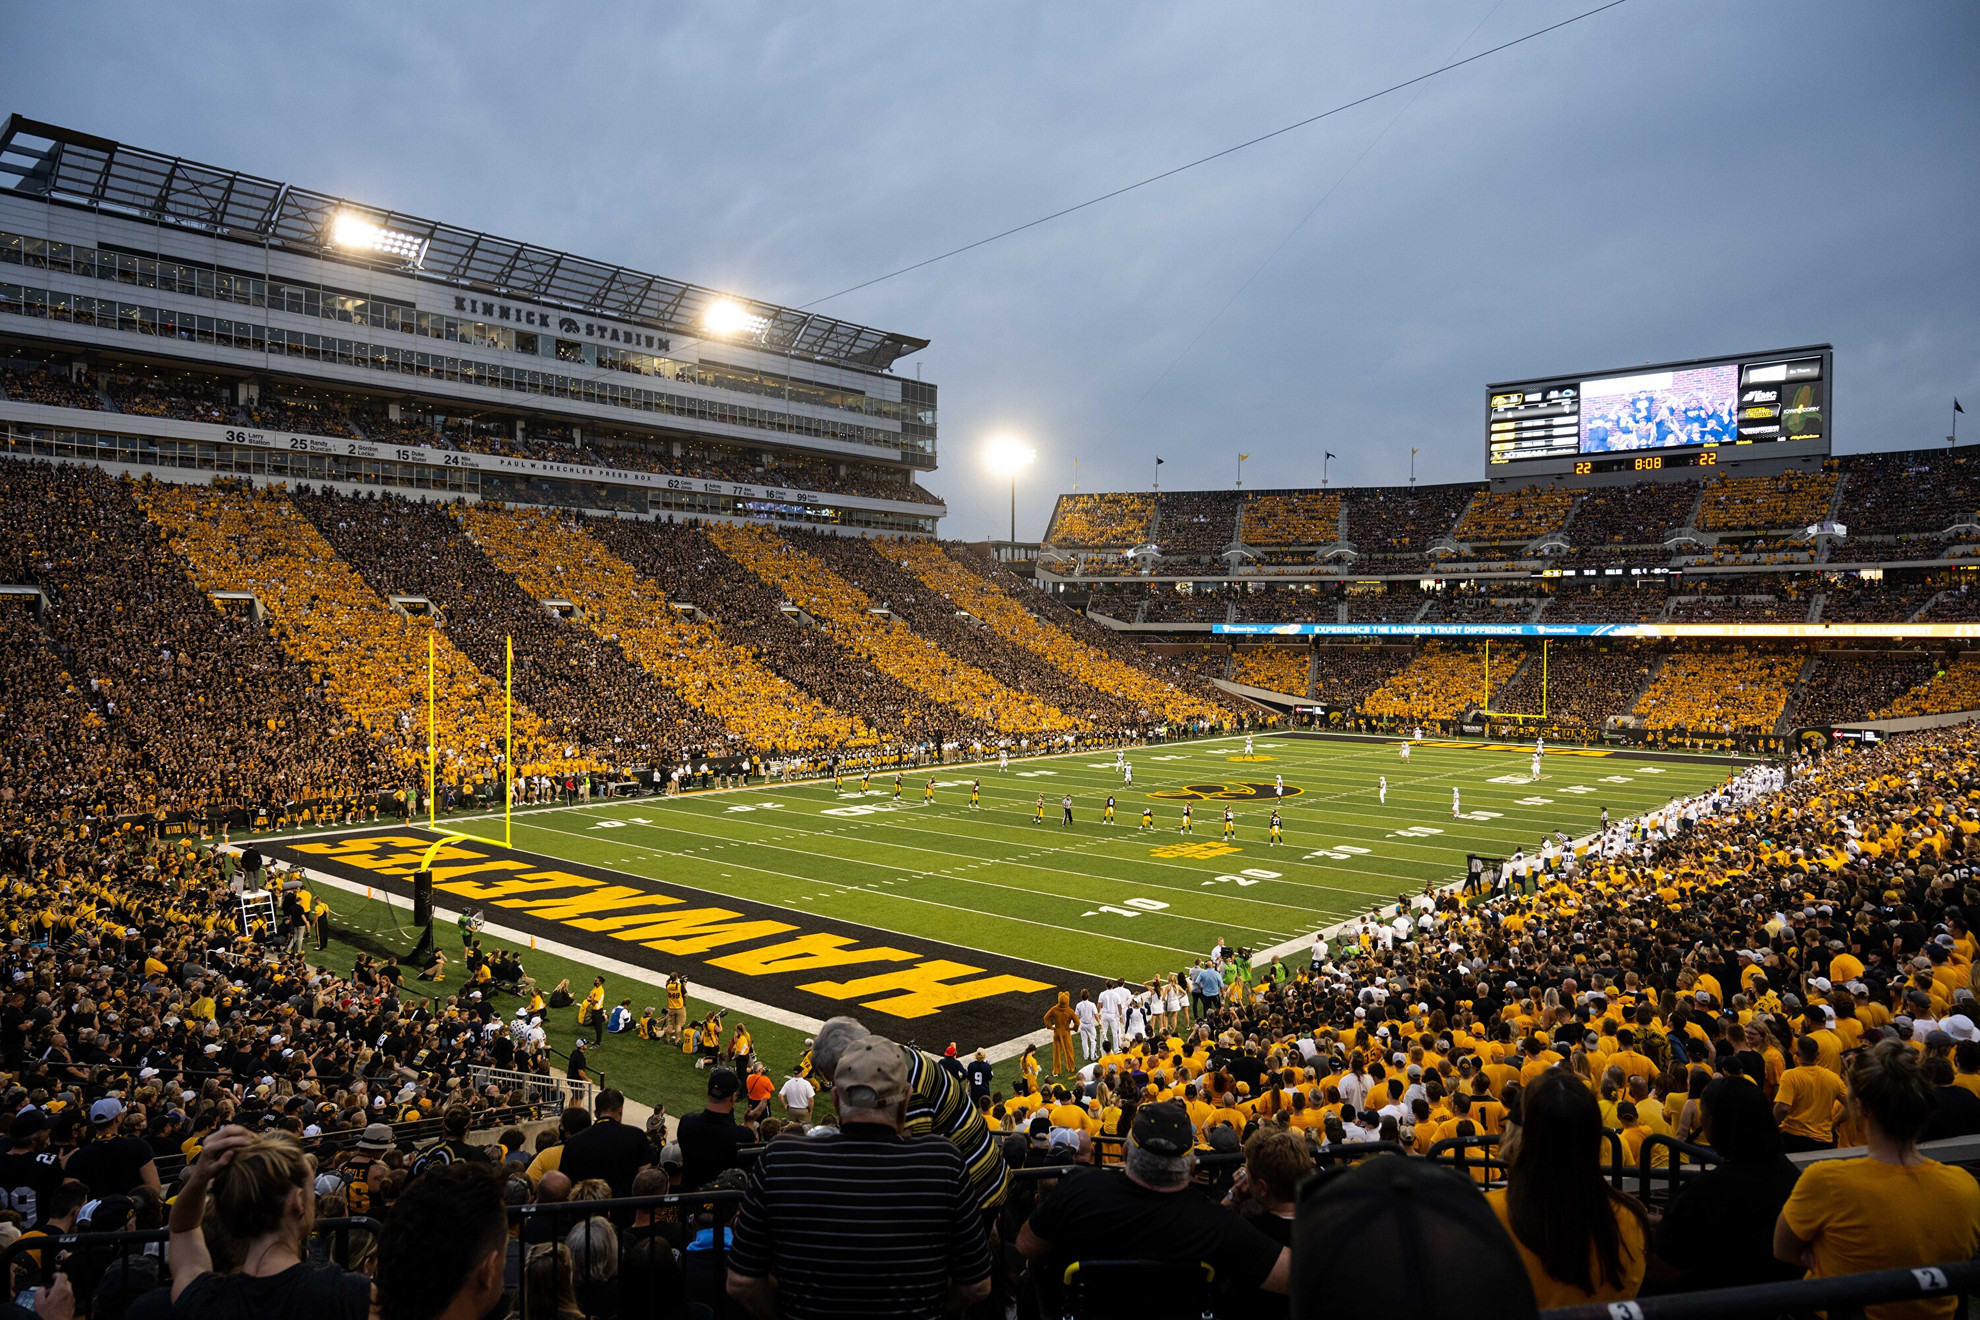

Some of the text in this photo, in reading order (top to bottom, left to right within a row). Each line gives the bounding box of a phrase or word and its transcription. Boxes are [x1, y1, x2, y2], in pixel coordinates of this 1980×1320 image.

[454, 296, 671, 351] KINNICK STADIUM
[226, 430, 246, 442] 36
[248, 432, 264, 440] Larry
[248, 438, 270, 446] Station
[290, 438, 308, 450] 25
[348, 444, 356, 454] 2
[396, 450, 409, 460] 15
[444, 455, 459, 465] 24
[1700, 452, 1716, 466] 22
[500, 460, 526, 468] PAUL
[543, 464, 593, 475] BRECHLER
[600, 470, 628, 479] PRESS
[1576, 462, 1592, 474] 22
[1635, 457, 1662, 470] 8:08
[668, 480, 680, 488] 62
[704, 483, 708, 491] 1
[733, 486, 743, 495] 77
[766, 490, 774, 498] 16
[797, 494, 807, 502] 99
[1314, 626, 1370, 634] EXPERIENCE
[1804, 626, 1854, 634] WEALTH
[1856, 626, 1932, 634] MANAGEMENT
[1489, 724, 1538, 738] KINCK
[1311, 845, 1372, 859] 30
[1214, 868, 1283, 886] 20
[1953, 868, 1970, 881] 16
[1098, 897, 1170, 918] 10
[286, 836, 1057, 1019] HAWKEYES
[974, 1072, 983, 1086] 9
[1923, 1270, 1938, 1288] 2
[1617, 1304, 1633, 1319] 3
